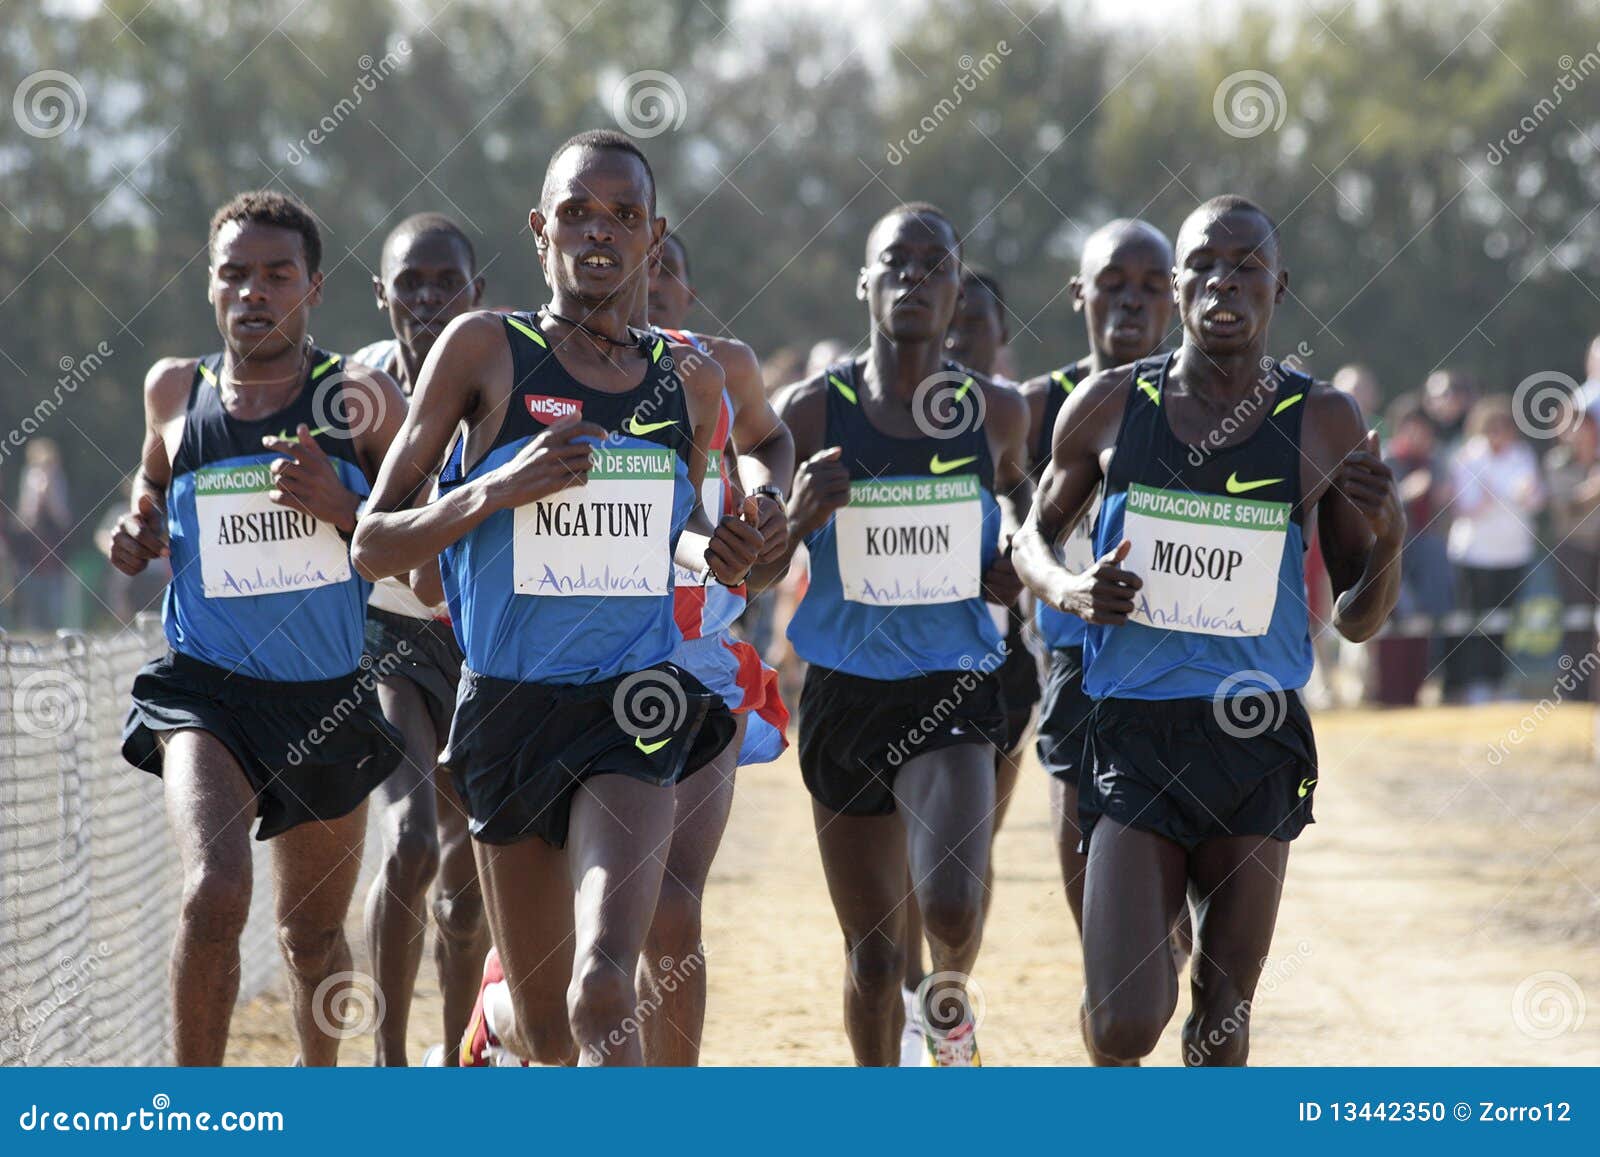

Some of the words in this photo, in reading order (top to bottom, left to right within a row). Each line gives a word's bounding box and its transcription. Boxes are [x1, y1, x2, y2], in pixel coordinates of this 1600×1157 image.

[531, 398, 577, 417] NISSIN
[606, 455, 624, 473] DE
[626, 455, 671, 473] SEVILLA
[198, 472, 266, 490] DIPUTACION
[850, 486, 913, 503] PUTACION
[916, 485, 930, 501] DE
[935, 481, 978, 500] SEVILLA
[535, 502, 652, 537] NGATUNY
[1131, 491, 1211, 518] DIPUTACION
[1213, 504, 1232, 521] DE
[1234, 504, 1286, 526] SEVILLA
[218, 510, 317, 545] ABSHIRO
[866, 525, 950, 556] KOMON
[1151, 539, 1243, 582] MOSOP
